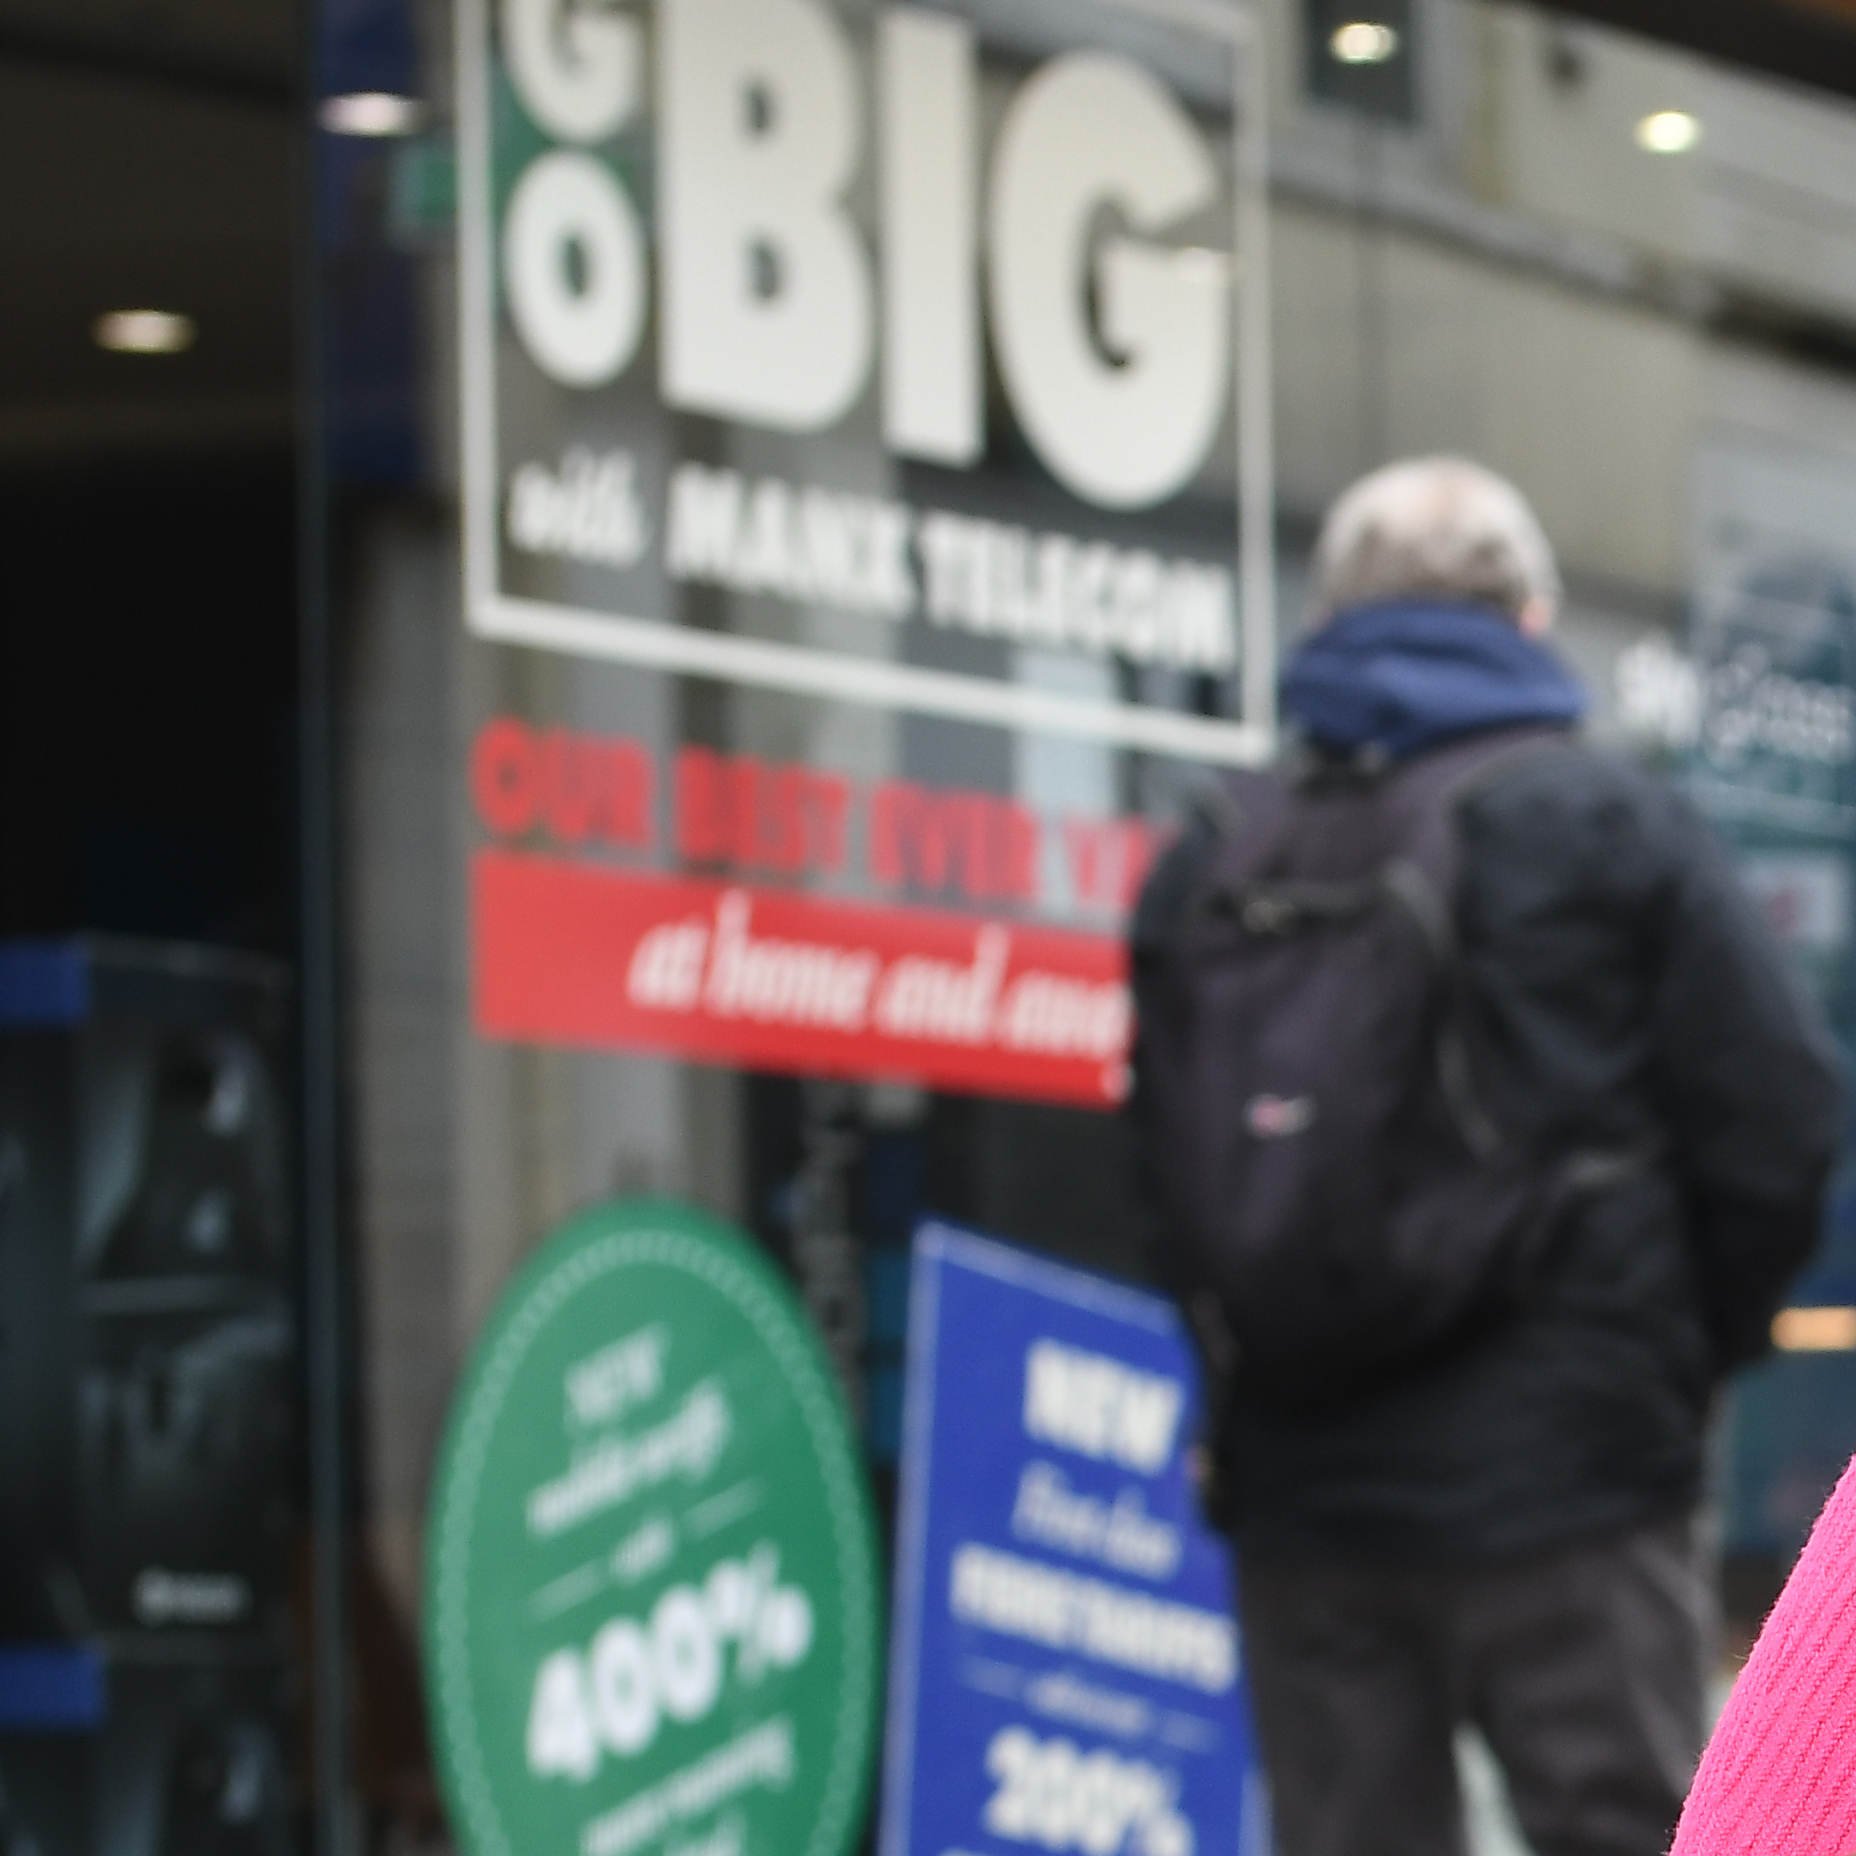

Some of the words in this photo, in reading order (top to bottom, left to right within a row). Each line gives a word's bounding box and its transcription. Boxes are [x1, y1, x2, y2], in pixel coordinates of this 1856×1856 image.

[500, 0, 648, 388] GO
[660, 0, 1232, 510] BIG
[665, 462, 915, 618] MANX
[918, 508, 1238, 675] TELECOM
[470, 712, 655, 850] OUR
[702, 888, 880, 1034] home
[872, 922, 1010, 1048] and
[525, 1535, 814, 1785] 400%
